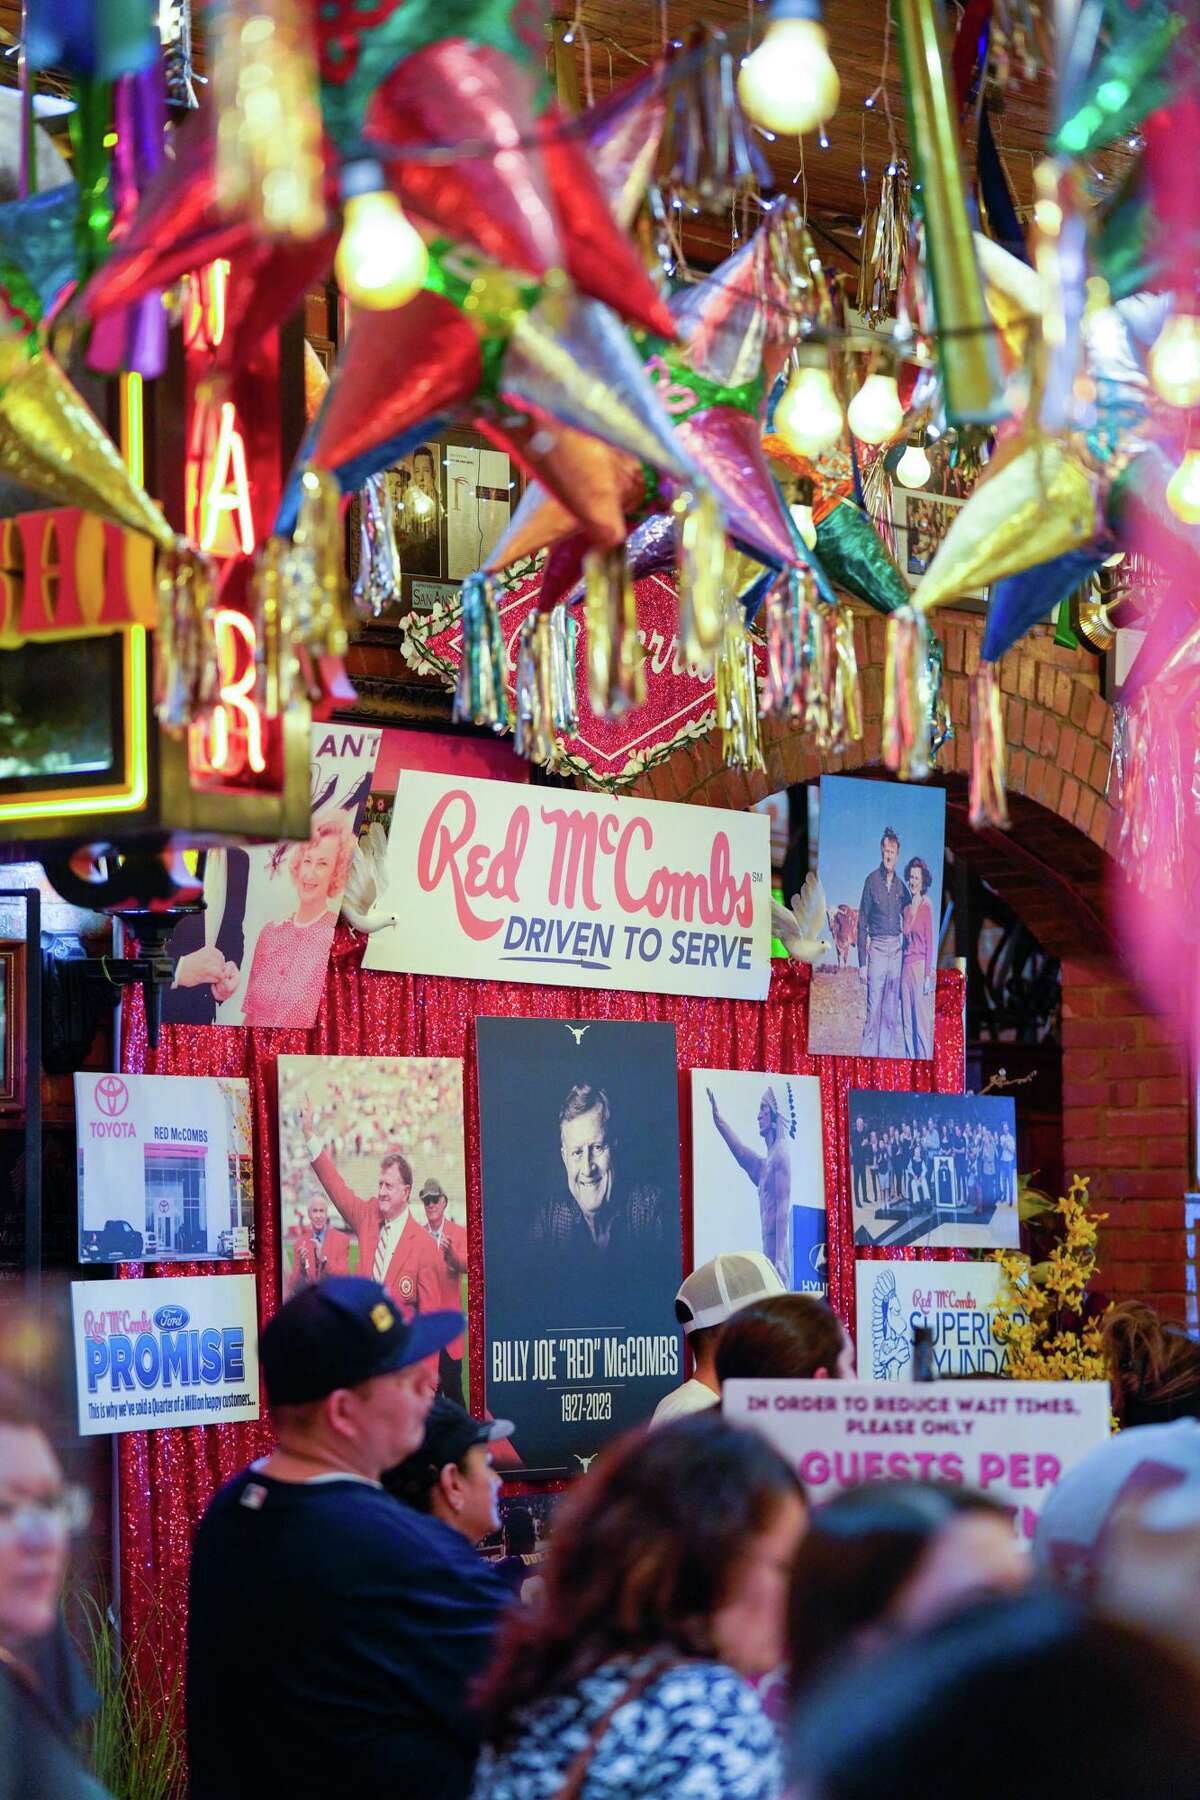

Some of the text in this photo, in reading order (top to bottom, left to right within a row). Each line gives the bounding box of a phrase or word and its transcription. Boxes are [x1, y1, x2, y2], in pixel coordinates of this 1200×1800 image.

[418, 789, 530, 941] Red
[541, 804, 754, 929] McCombs
[504, 916, 753, 970] DRIVEN TO SERVE
[90, 1122, 136, 1138] TOYOTA
[154, 1126, 208, 1143] RED McCOMBS
[802, 1279, 828, 1297] HYU
[912, 1288, 977, 1315] Red McCombs
[84, 1310, 106, 1345] Red
[160, 1309, 184, 1327] Ford
[84, 1327, 246, 1393] PROMISE
[492, 1340, 529, 1383] BILLY
[532, 1339, 557, 1381] JOE
[604, 1335, 679, 1378] McCOMBS
[88, 1403, 100, 1419] This
[100, 1403, 106, 1419] is
[106, 1400, 118, 1420] why
[118, 1400, 135, 1417] we've
[135, 1397, 148, 1416] sold
[152, 1397, 173, 1417] Quarter
[174, 1395, 180, 1412] of
[184, 1394, 204, 1411] Million
[204, 1393, 221, 1412] happy
[561, 1391, 612, 1423] 1927-2023
[748, 1395, 769, 1411] IN
[774, 1395, 837, 1412] ORDER
[843, 1397, 869, 1413] TO
[874, 1397, 950, 1413] REDUCE
[958, 1397, 1007, 1413] WAIT
[846, 1419, 975, 1436] PLEASE ONLY
[800, 1450, 1062, 1489] GUESTS PER
